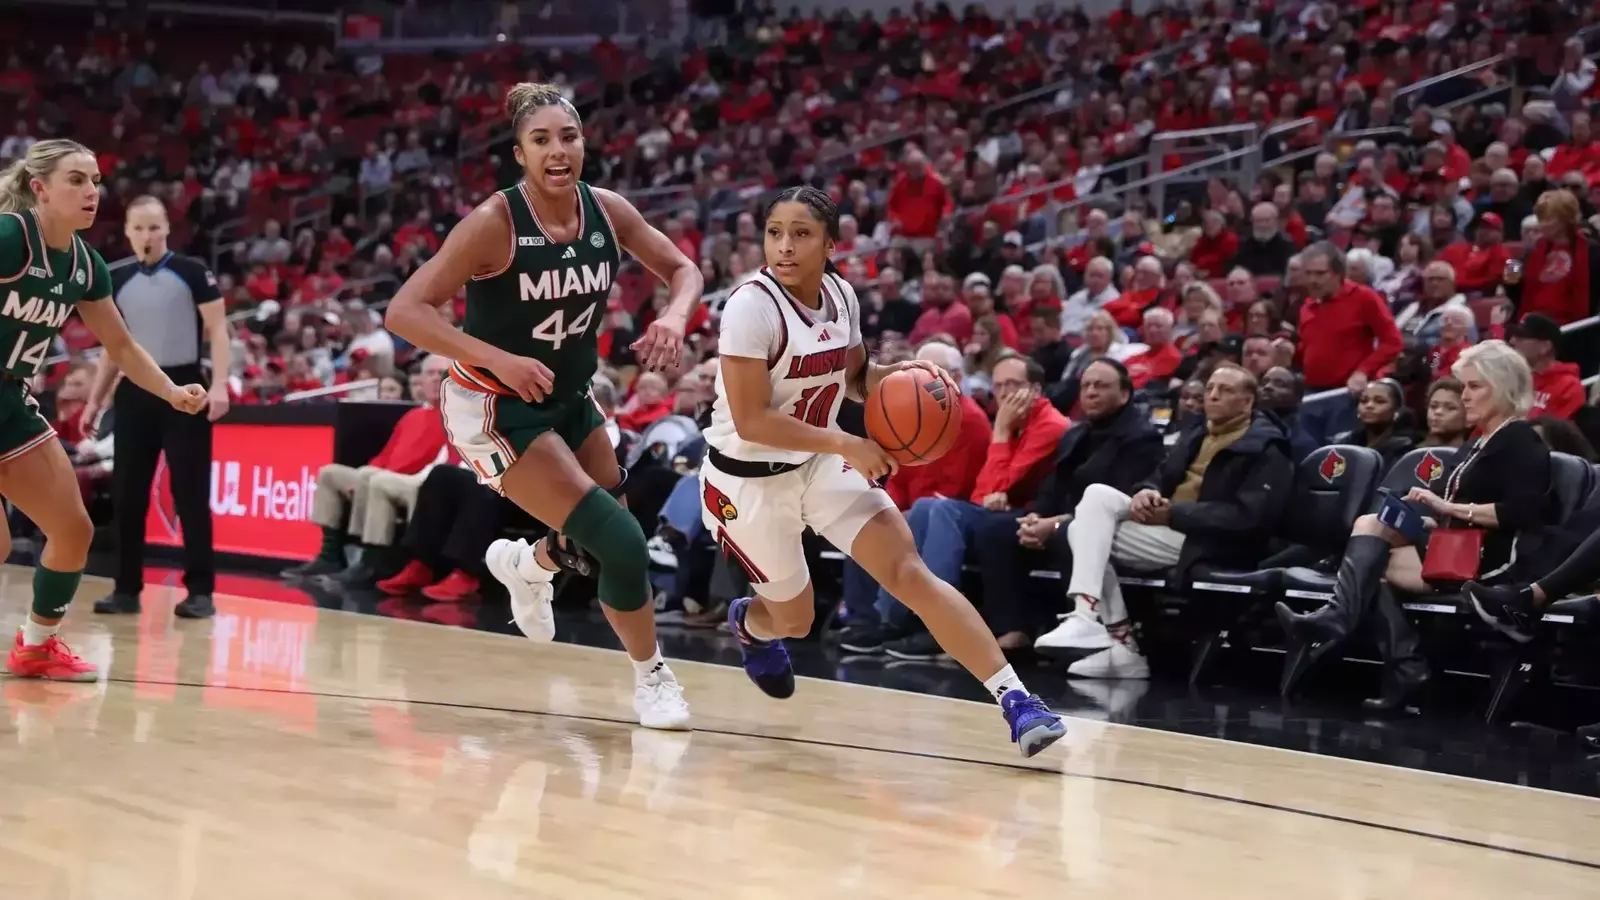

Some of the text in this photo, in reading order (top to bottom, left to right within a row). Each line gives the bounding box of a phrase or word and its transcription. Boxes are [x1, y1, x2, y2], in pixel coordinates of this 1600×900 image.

[519, 261, 610, 301] MIAMI
[1, 290, 75, 328] MIAM
[532, 301, 597, 350] 44
[6, 330, 51, 374] 14
[788, 383, 840, 428] 10
[251, 465, 318, 521] Healt
